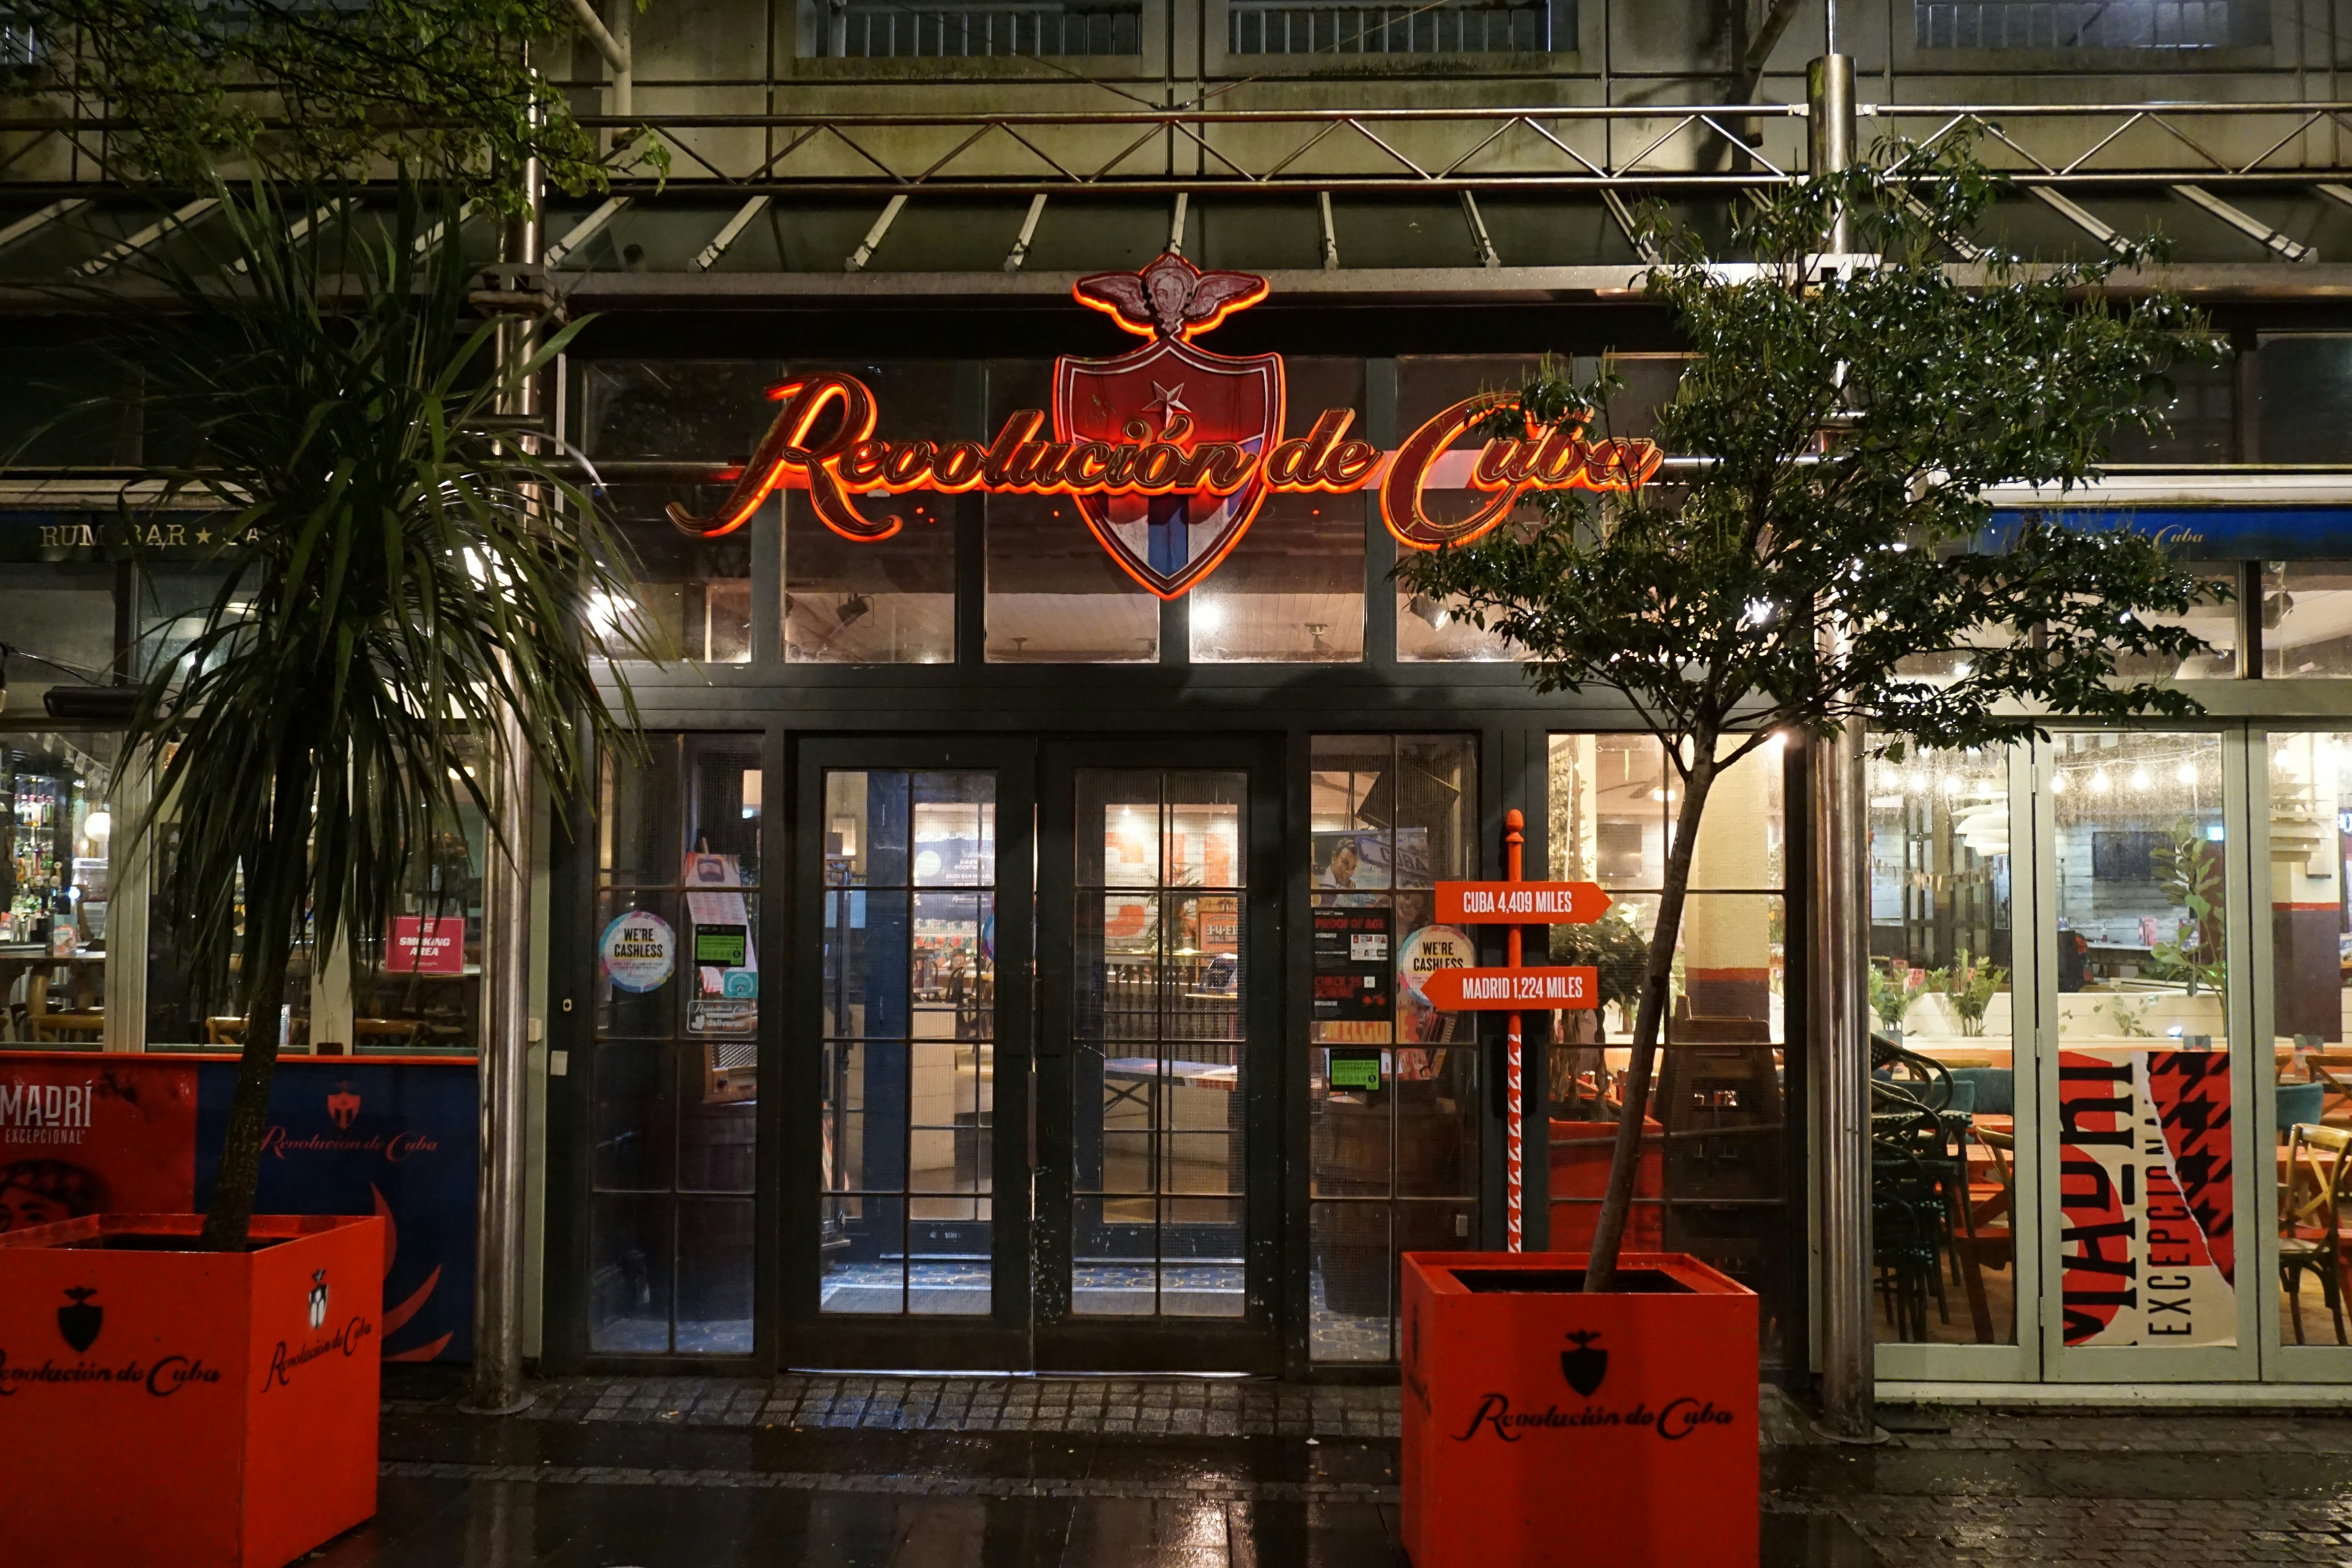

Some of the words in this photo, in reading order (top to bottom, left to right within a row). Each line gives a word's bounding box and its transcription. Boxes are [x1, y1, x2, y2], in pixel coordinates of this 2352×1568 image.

[665, 372, 1260, 543] Revolución
[1261, 407, 1388, 493] de
[1381, 392, 1664, 549] Cuba
[39, 525, 104, 547] RUM
[2152, 524, 2204, 554] Cuba
[1464, 891, 1495, 913] CUBA
[1498, 891, 1532, 913] 4,409
[1536, 891, 1572, 913] MILES
[624, 928, 653, 941] WE'RE
[614, 944, 663, 958] CASHLESS
[1423, 942, 1454, 955] WE'RE
[1414, 958, 1463, 971] CASHLESS
[1463, 978, 1510, 999] MADRID
[1513, 977, 1543, 1000] 1,224
[1546, 976, 1583, 998] MILES
[0, 1080, 93, 1127] MADRÍ
[5, 1129, 82, 1144] EXCEPCIONAL
[364, 1136, 383, 1151] de
[386, 1132, 438, 1162] Cuba
[2143, 1099, 2192, 1336] EXCEPCIO
[343, 1316, 372, 1357] Cuba
[116, 1361, 143, 1382] de
[146, 1356, 221, 1396] Cuba
[1624, 1403, 1655, 1427] de
[1657, 1397, 1734, 1440] Cuba
